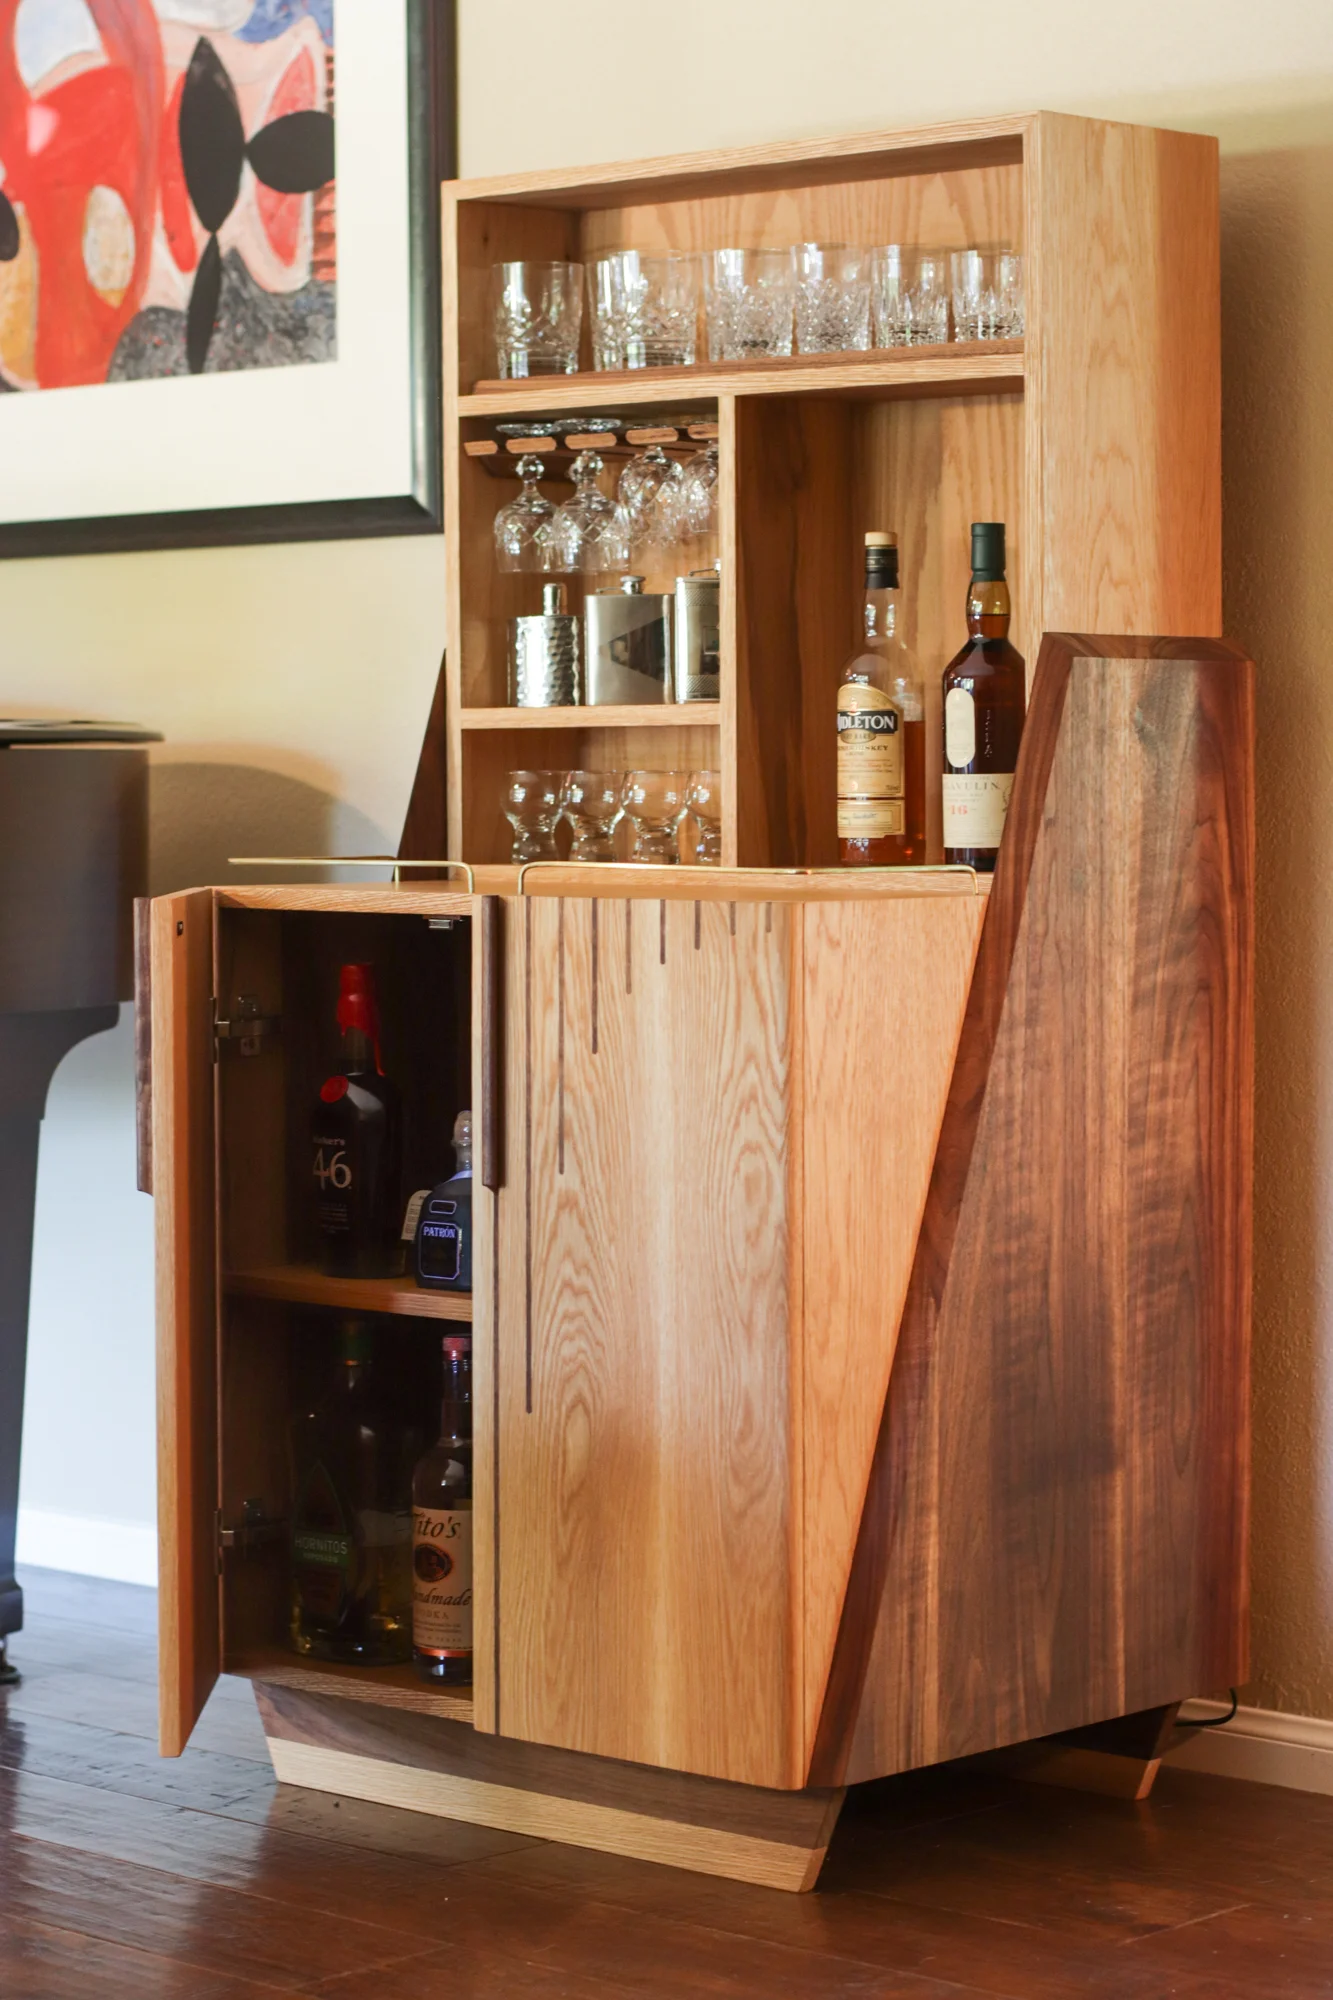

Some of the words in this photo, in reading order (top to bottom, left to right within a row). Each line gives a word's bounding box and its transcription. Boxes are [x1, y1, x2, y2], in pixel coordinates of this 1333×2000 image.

[950, 804, 968, 815] 16
[312, 1147, 353, 1191] 46
[422, 1225, 456, 1239] PATRÓN
[294, 1535, 348, 1555] HORNITOS
